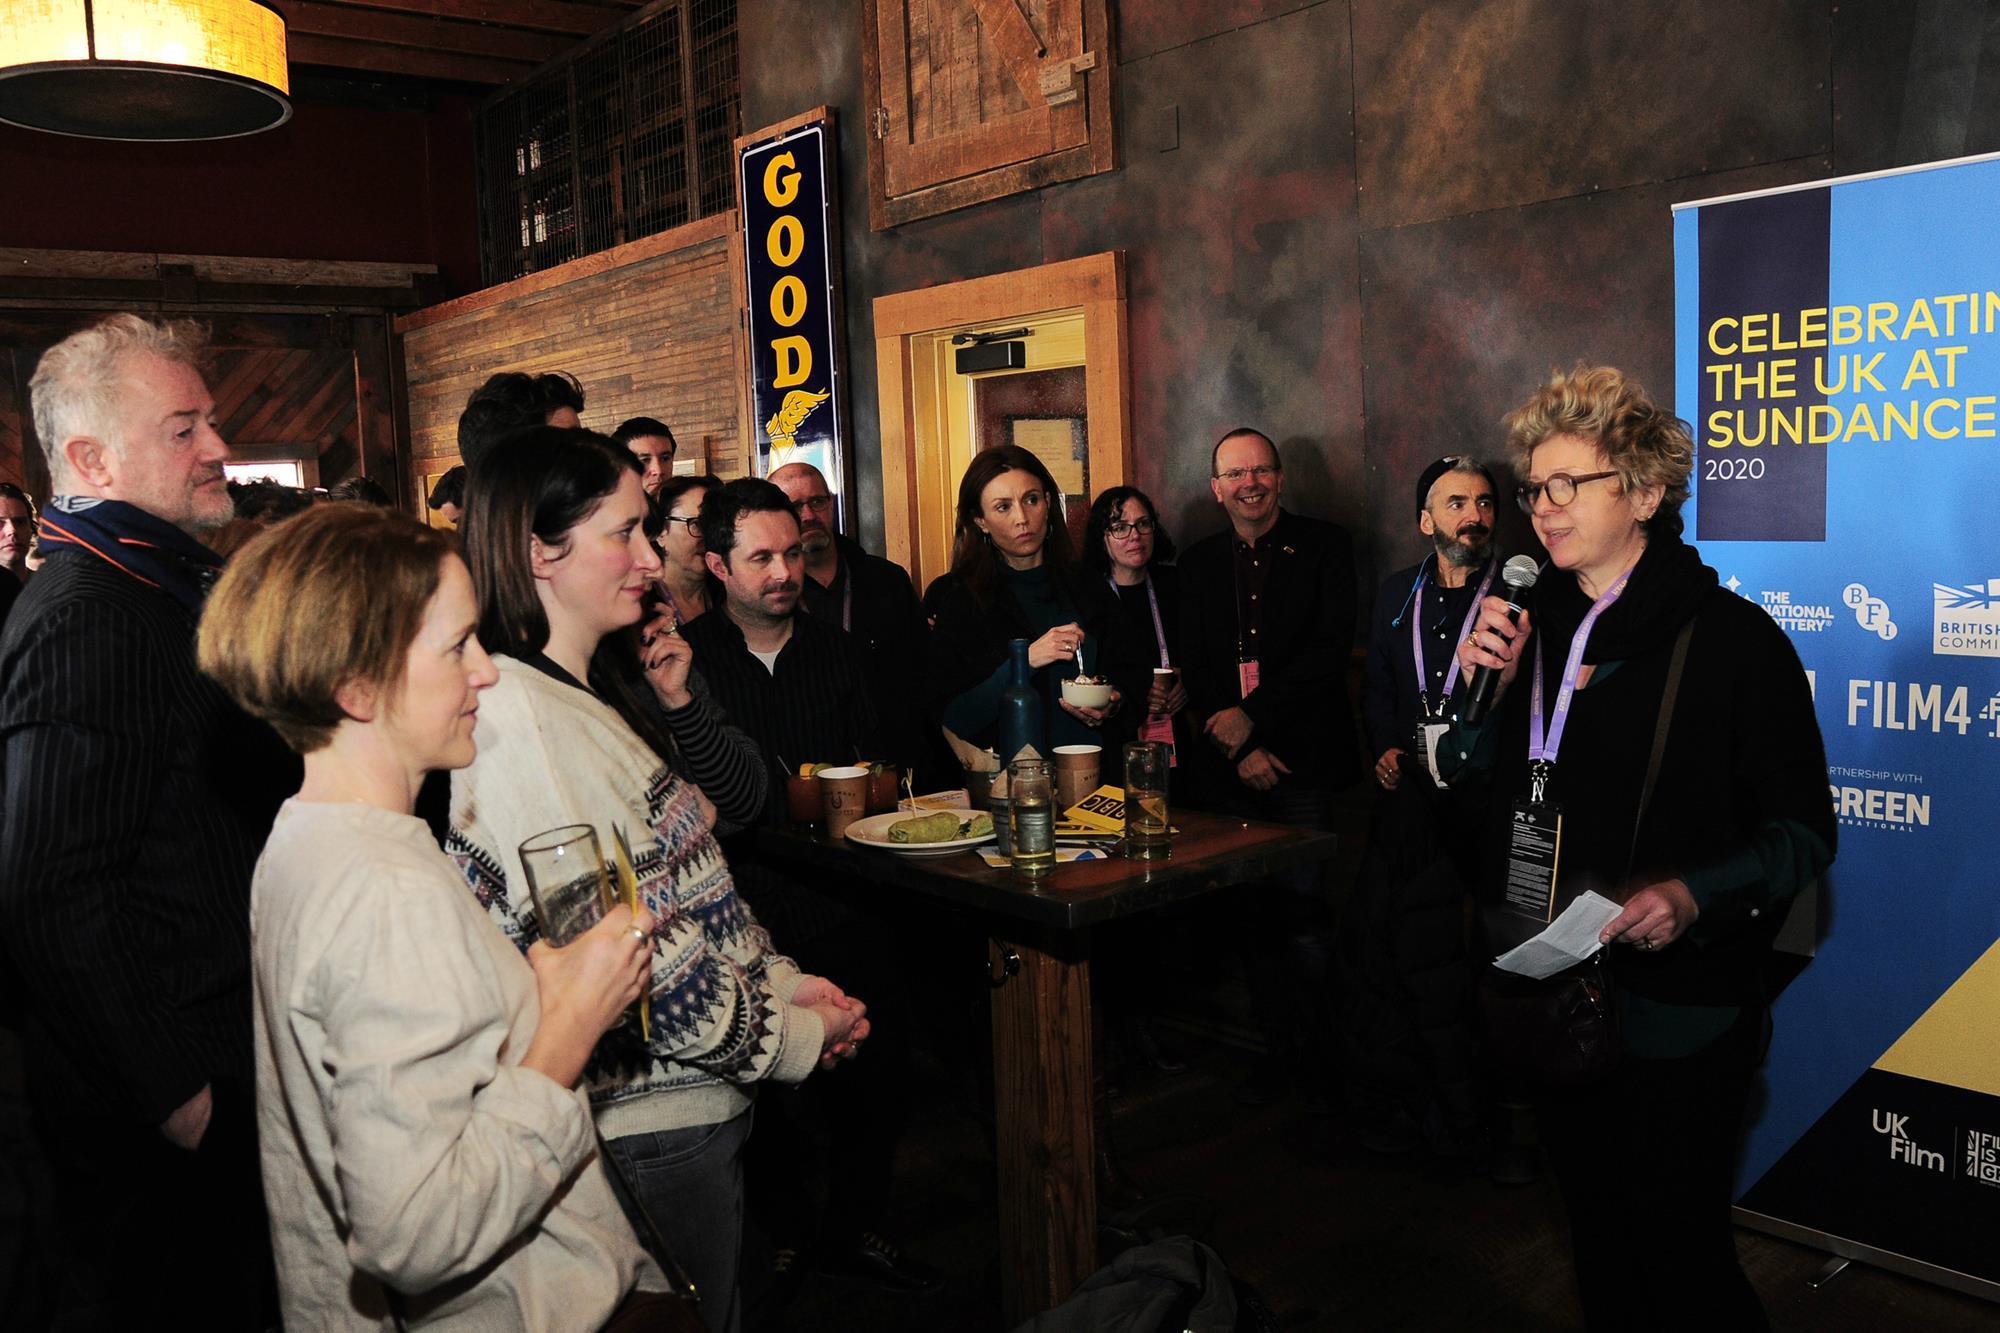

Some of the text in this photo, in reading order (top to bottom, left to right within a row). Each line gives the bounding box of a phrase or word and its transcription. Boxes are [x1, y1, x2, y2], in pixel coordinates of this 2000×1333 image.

[763, 150, 813, 389] GOOD
[1706, 346, 1969, 401] THE UK AT
[1707, 396, 1997, 448] SUNDANCE
[1705, 457, 1765, 481] 2020
[1761, 591, 1790, 604] THE
[1761, 604, 1834, 619] NATIONAL
[1849, 587, 1891, 637] BFI
[1774, 617, 1826, 632] TTERY
[1848, 679, 1971, 735] FILM4
[1828, 766, 1923, 784] RTNERSHIP WITH
[1872, 1108, 1910, 1140] UK
[1890, 1137, 1945, 1172] Film
[1981, 1147, 1997, 1163] IS
